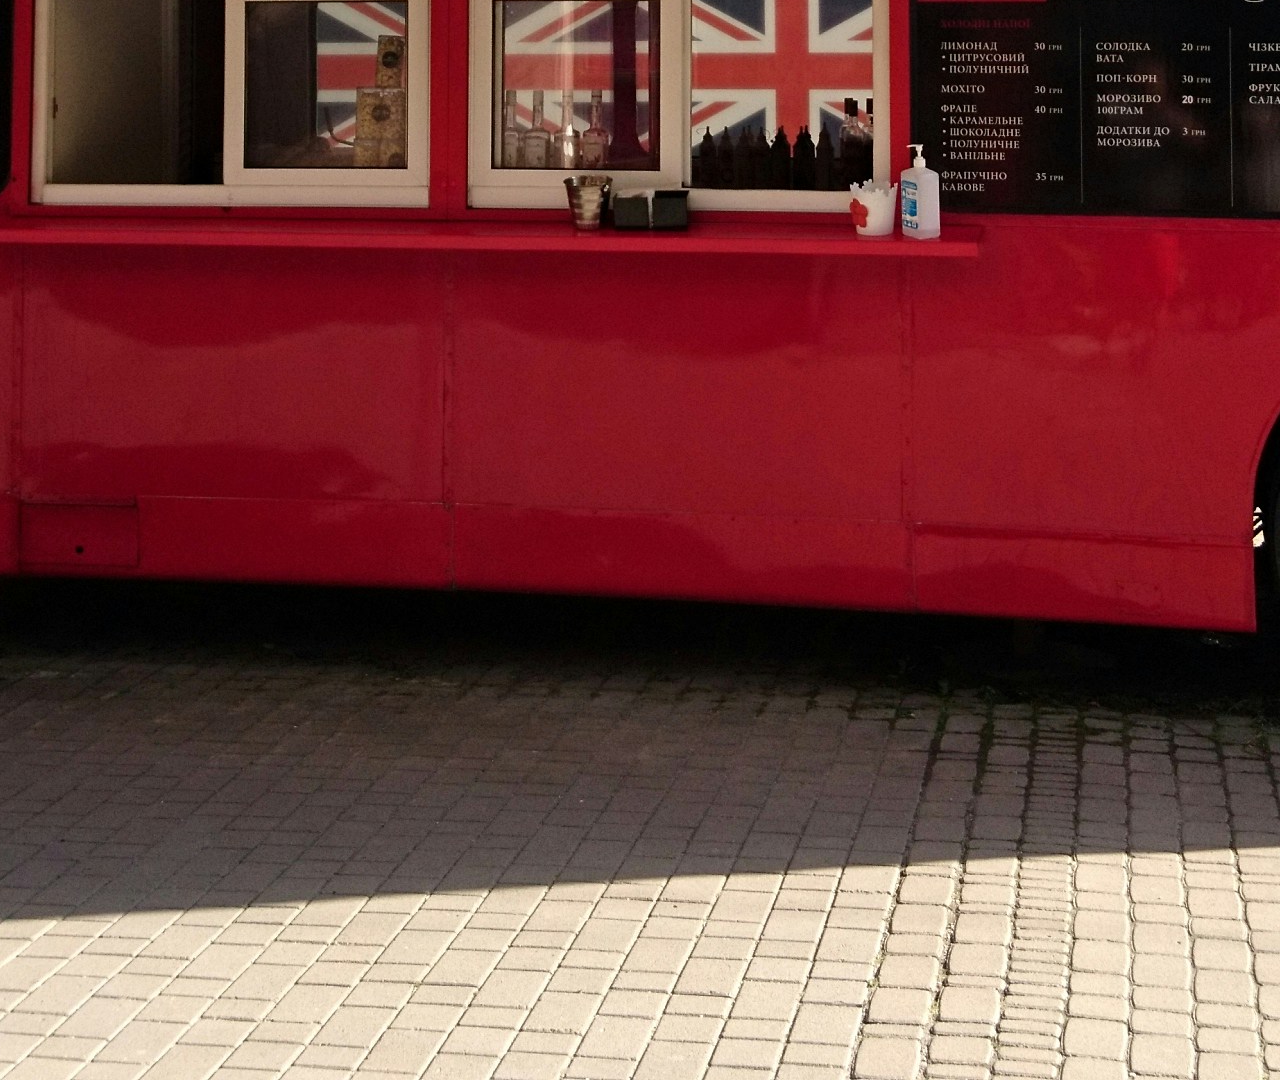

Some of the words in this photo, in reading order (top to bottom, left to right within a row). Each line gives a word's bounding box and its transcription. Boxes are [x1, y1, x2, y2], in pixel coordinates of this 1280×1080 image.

[940, 42, 997, 51] ЛИМОНАД
[1034, 43, 1045, 51] 30
[1096, 42, 1150, 52] СОЛОДКА
[1181, 44, 1193, 52] 20
[950, 53, 1025, 63] ЦИТРУСОВИЙ
[1096, 54, 1124, 63] ВАТА
[950, 65, 1029, 74] ПОЛУНИЧНИЙ
[1096, 74, 1156, 83] ПОП-КОРН
[1182, 75, 1193, 83] 30
[941, 85, 985, 94] МОХІТО
[1035, 86, 1045, 94] 30
[1096, 94, 1161, 103] МОРОЗИВО
[1182, 95, 1194, 104] 20
[941, 105, 977, 113] ФРАПЕ
[1035, 106, 1046, 114] 40
[1096, 106, 1143, 115] 100ГРАМ
[950, 117, 1023, 125] КАРАМЕЛЬНЕ
[950, 129, 1021, 137] ШОКОЛАДНЕ
[1096, 126, 1150, 136] ДОДАТКИ
[1154, 127, 1170, 136] ДО
[1183, 127, 1188, 136] 3
[950, 140, 1019, 149] ПОЛУНИЧНЕ
[1097, 138, 1160, 147] МОРОЗИВА
[950, 152, 1005, 161] ВАНІЛЬНЕ
[941, 172, 1007, 180] ФРАПУЧІНО
[1035, 173, 1046, 181] 35
[942, 183, 985, 192] КАВОВЕ
